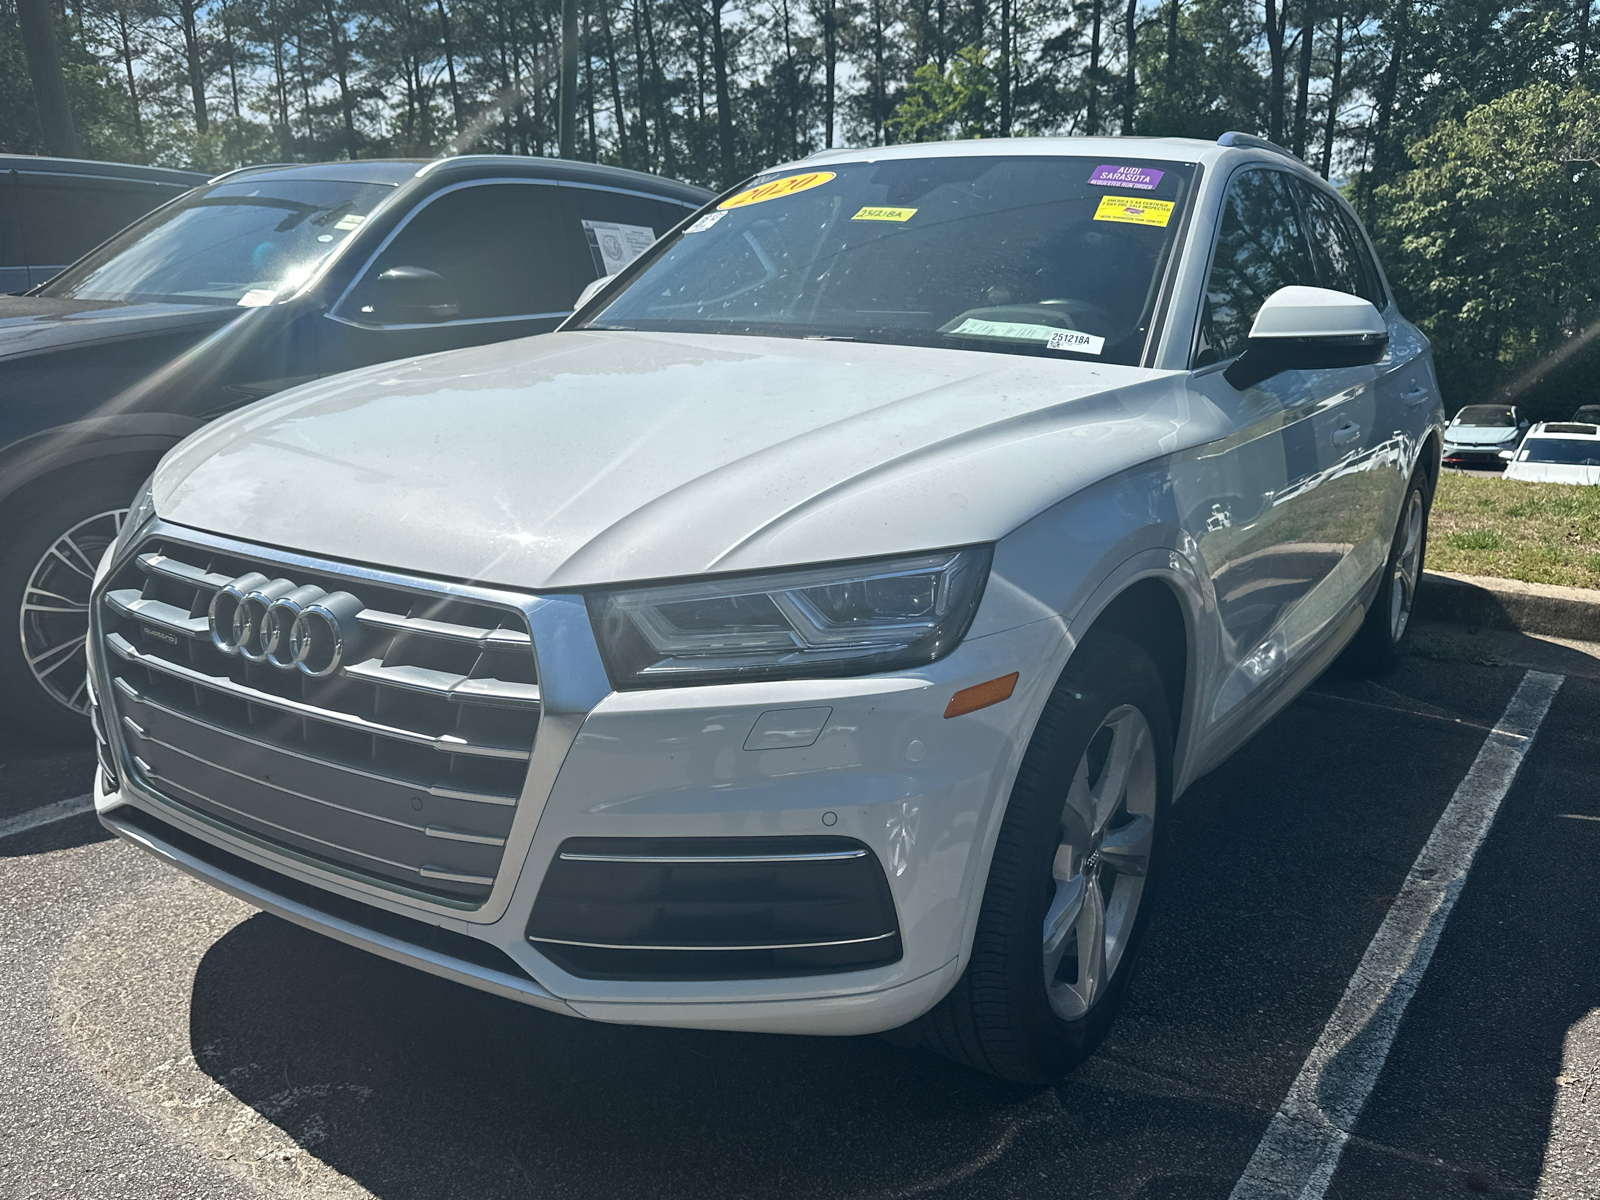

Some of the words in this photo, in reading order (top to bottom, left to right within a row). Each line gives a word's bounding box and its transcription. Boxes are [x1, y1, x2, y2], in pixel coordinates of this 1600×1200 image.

[1117, 166, 1142, 175] AUDI
[1099, 172, 1151, 183] SARASOTA
[730, 174, 819, 206] 2020
[1051, 332, 1090, 345] 251218A
